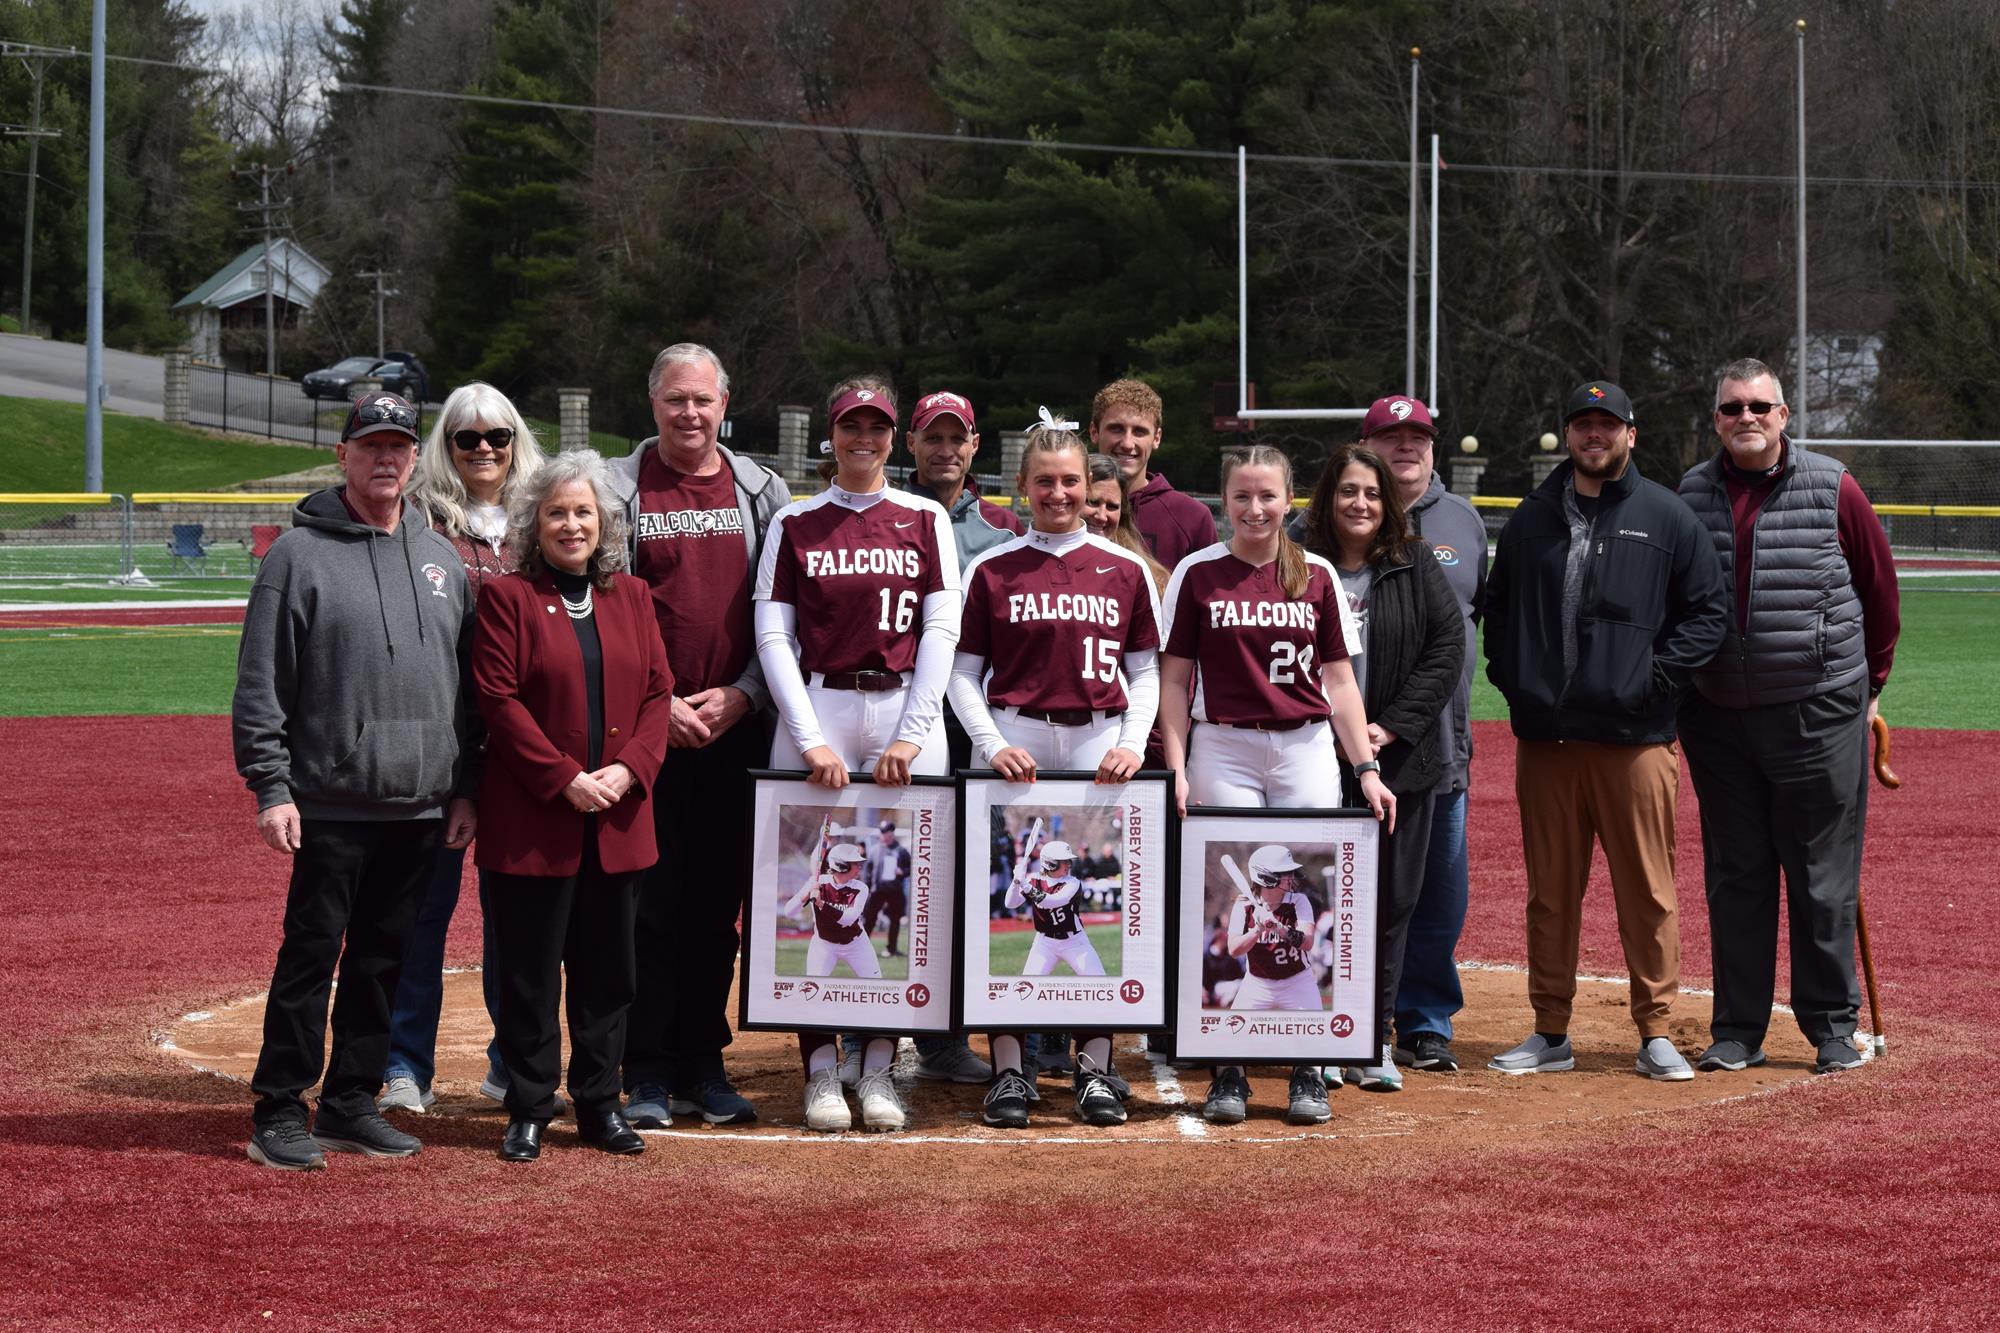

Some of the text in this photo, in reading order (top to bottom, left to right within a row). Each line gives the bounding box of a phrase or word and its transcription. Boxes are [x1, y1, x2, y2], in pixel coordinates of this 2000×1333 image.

[638, 510, 704, 534] FALCON
[806, 548, 919, 578] FALCONS
[878, 587, 918, 633] 16
[1009, 592, 1120, 627] FALCONS
[1209, 600, 1316, 632] FALCONS
[1081, 636, 1121, 684] 15
[1269, 640, 1314, 684] 24
[1128, 804, 1142, 937] ABBEY AMMONS
[915, 809, 932, 967] MOLLY SCHWEITZER
[1050, 907, 1066, 926] 15
[1339, 842, 1354, 981] BROOKE SCHMITT
[1273, 945, 1300, 965] 24
[822, 990, 900, 1004] ATHLETICS
[908, 989, 927, 1002] 16
[1037, 989, 1114, 1001] ATHLETICS
[1122, 985, 1140, 998] 15
[1248, 1023, 1325, 1035] ATHLETICS
[1332, 1019, 1351, 1032] 24
